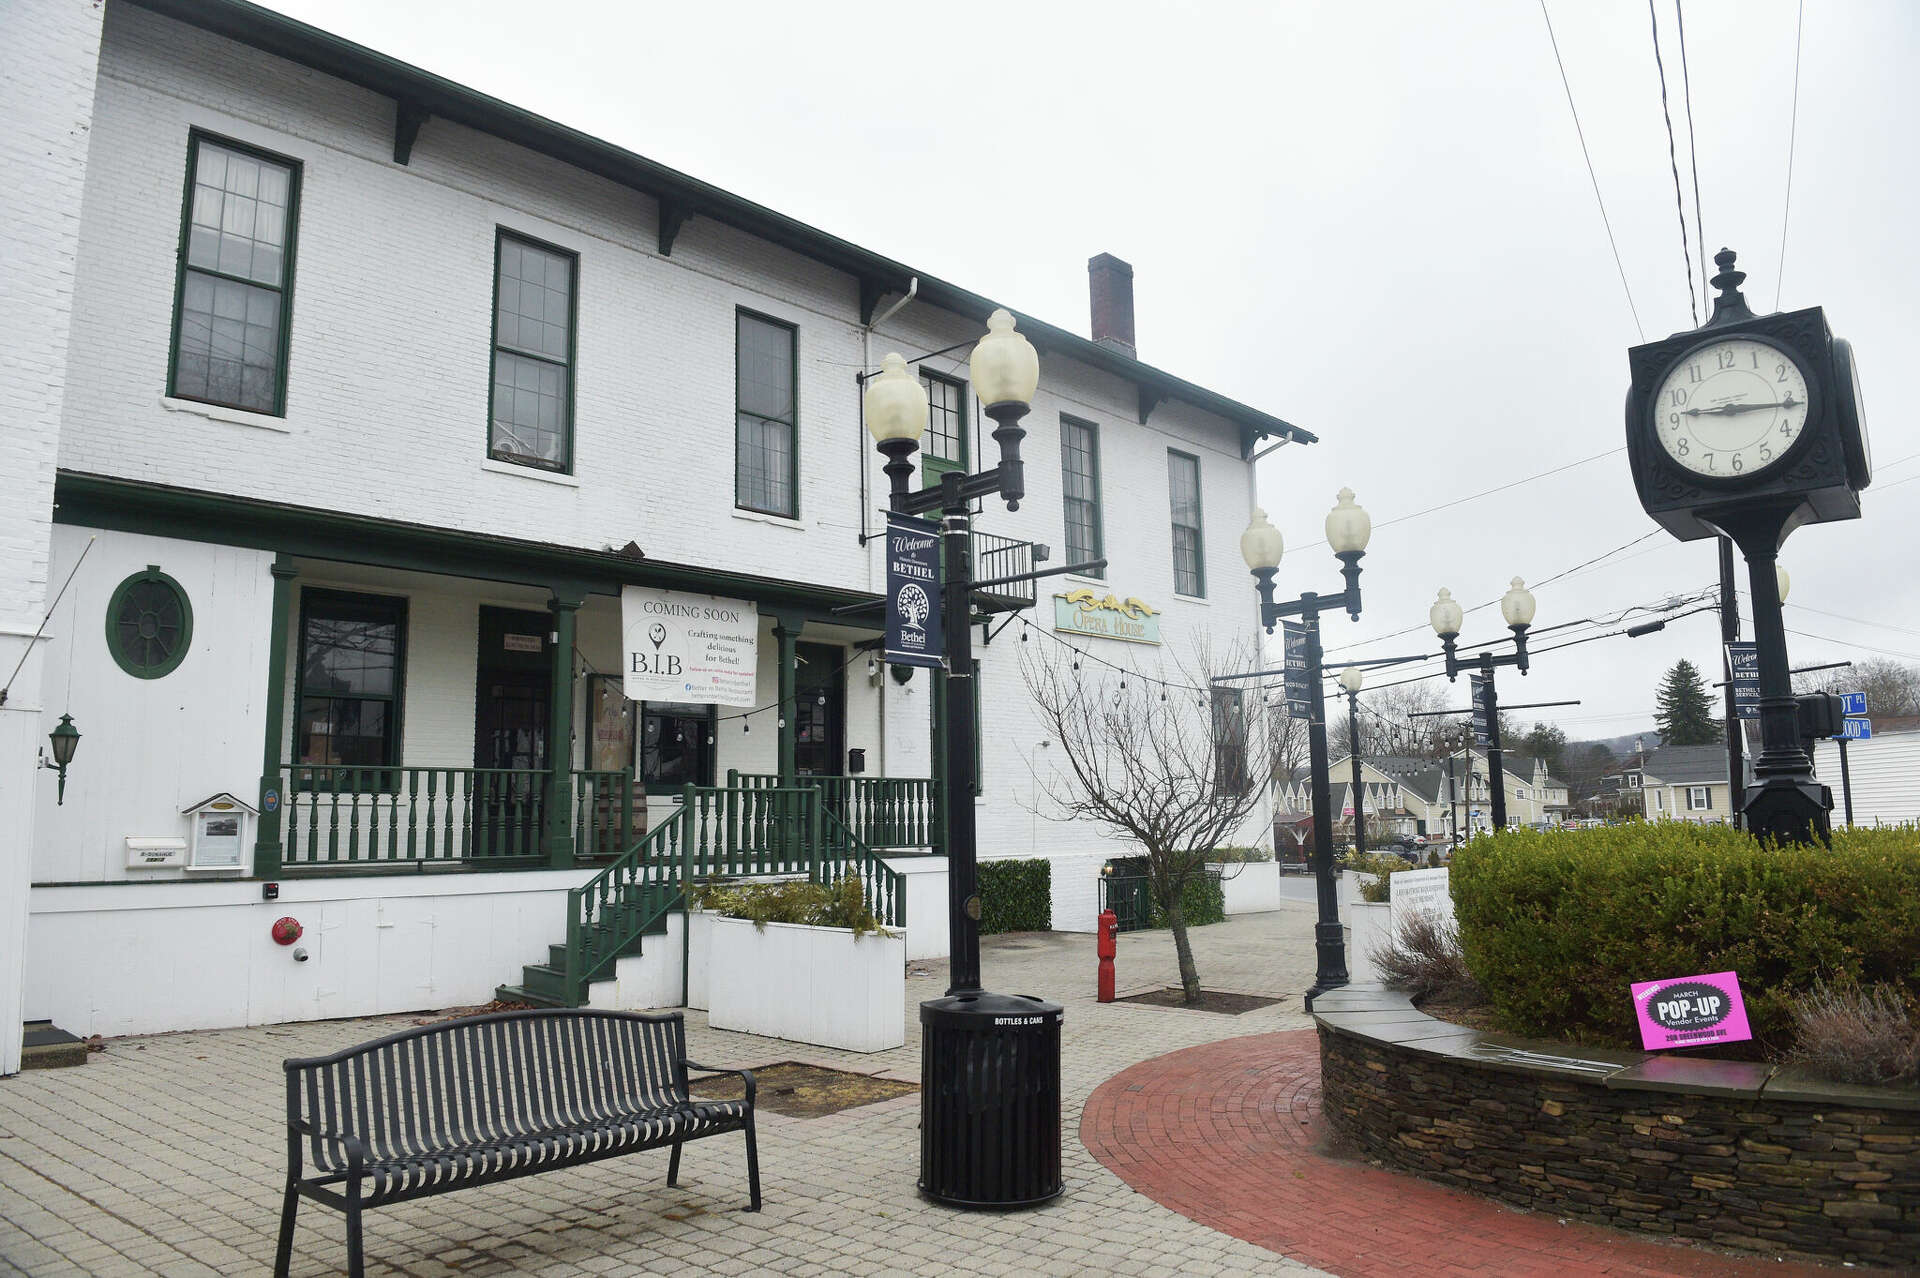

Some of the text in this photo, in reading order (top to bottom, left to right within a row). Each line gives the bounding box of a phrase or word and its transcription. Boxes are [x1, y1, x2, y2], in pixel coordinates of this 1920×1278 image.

[1716, 351, 1735, 370] 12
[1751, 352, 1760, 369] 1
[1688, 365, 1704, 383] 11
[1775, 364, 1789, 382] 2
[1670, 387, 1687, 406] 10
[1669, 412, 1680, 430] 9
[1779, 419, 1793, 438] 4
[1677, 438, 1690, 456] 8
[1760, 441, 1773, 461] 5
[1703, 453, 1714, 470] 7
[1731, 453, 1743, 472] 6
[892, 536, 935, 553] Welcome
[893, 561, 935, 579] BETHEL
[643, 601, 740, 624] COMING SOON
[687, 629, 755, 646] Crafting something
[900, 630, 926, 643] Bethel
[707, 642, 737, 654] delicious
[631, 652, 683, 676] B.I.B
[705, 653, 741, 666] for Bethel!
[1673, 990, 1699, 999] MARCH
[1657, 996, 1720, 1020] POP-UP
[994, 1017, 1022, 1025] BOTTLES
[1029, 1016, 1043, 1024] CANS
[1665, 1015, 1719, 1026] Vendor Events
